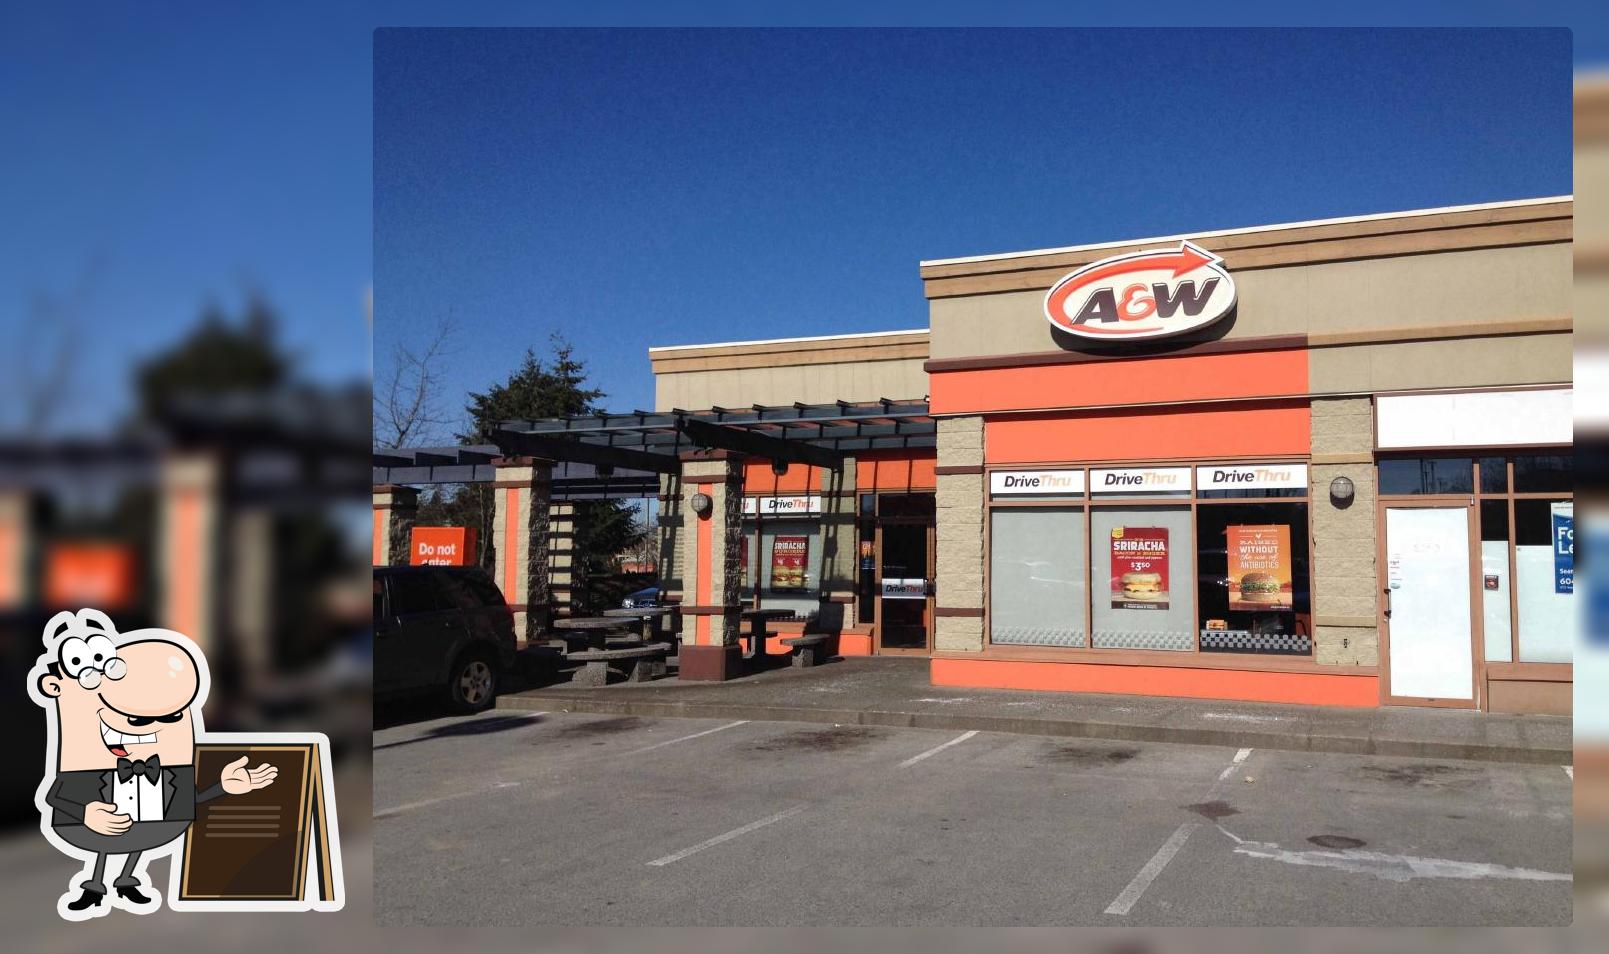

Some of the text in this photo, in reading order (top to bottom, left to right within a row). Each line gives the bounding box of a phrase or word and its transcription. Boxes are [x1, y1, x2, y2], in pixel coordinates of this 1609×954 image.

[1071, 276, 1221, 325] A&W
[1003, 474, 1072, 488] DriveThru
[1105, 472, 1177, 486] DriveThru
[1212, 469, 1291, 483] DriveThru
[768, 498, 814, 509] DriveThru
[419, 543, 456, 555] Do not
[774, 542, 807, 550] SRIRACHA
[1113, 541, 1166, 551] SRIRACHA
[1239, 545, 1279, 554] WITHOUT
[1240, 561, 1280, 569] ANTIBIOTICS
